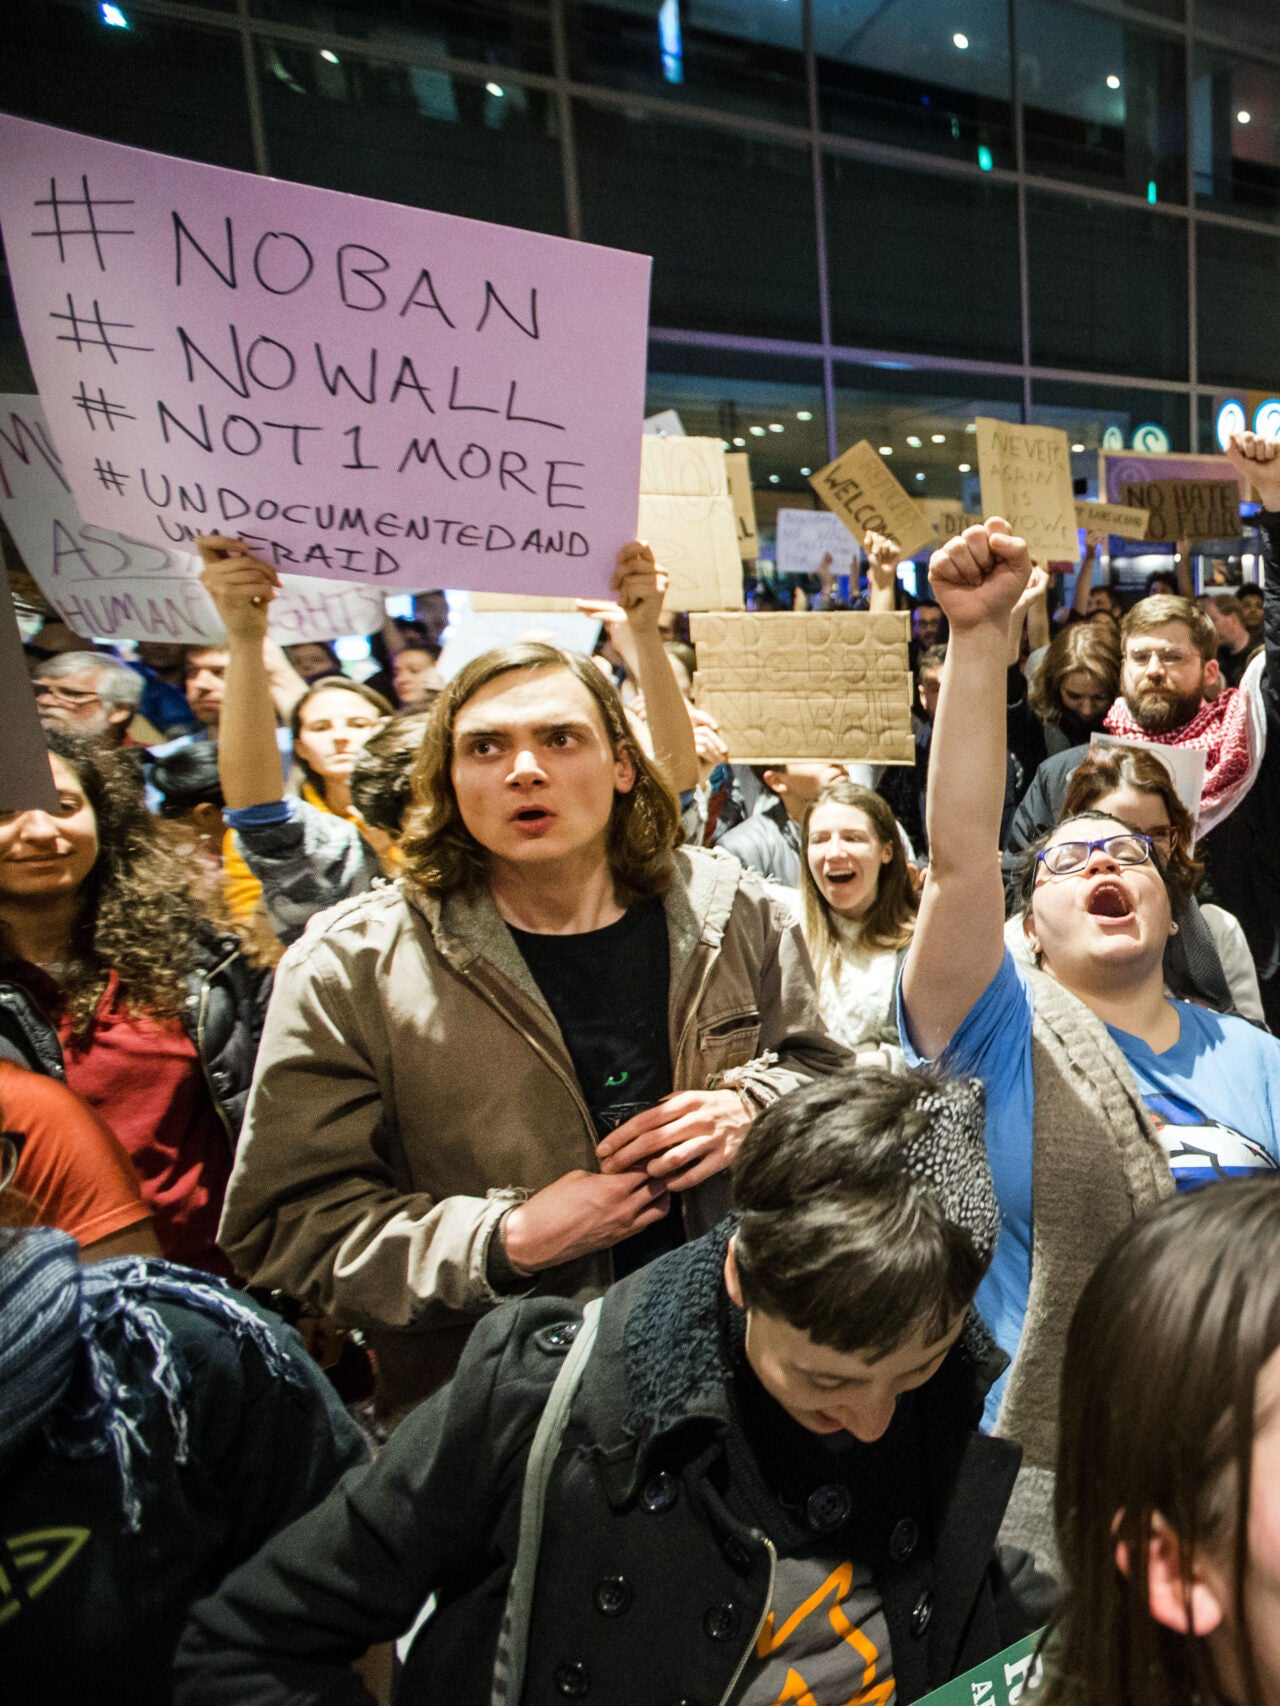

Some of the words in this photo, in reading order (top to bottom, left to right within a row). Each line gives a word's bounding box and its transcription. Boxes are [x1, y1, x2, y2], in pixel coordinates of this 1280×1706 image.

[992, 431, 1065, 471] NEVER
[157, 514, 400, 576] UNFRAID
[61, 592, 208, 638] HUMAN
